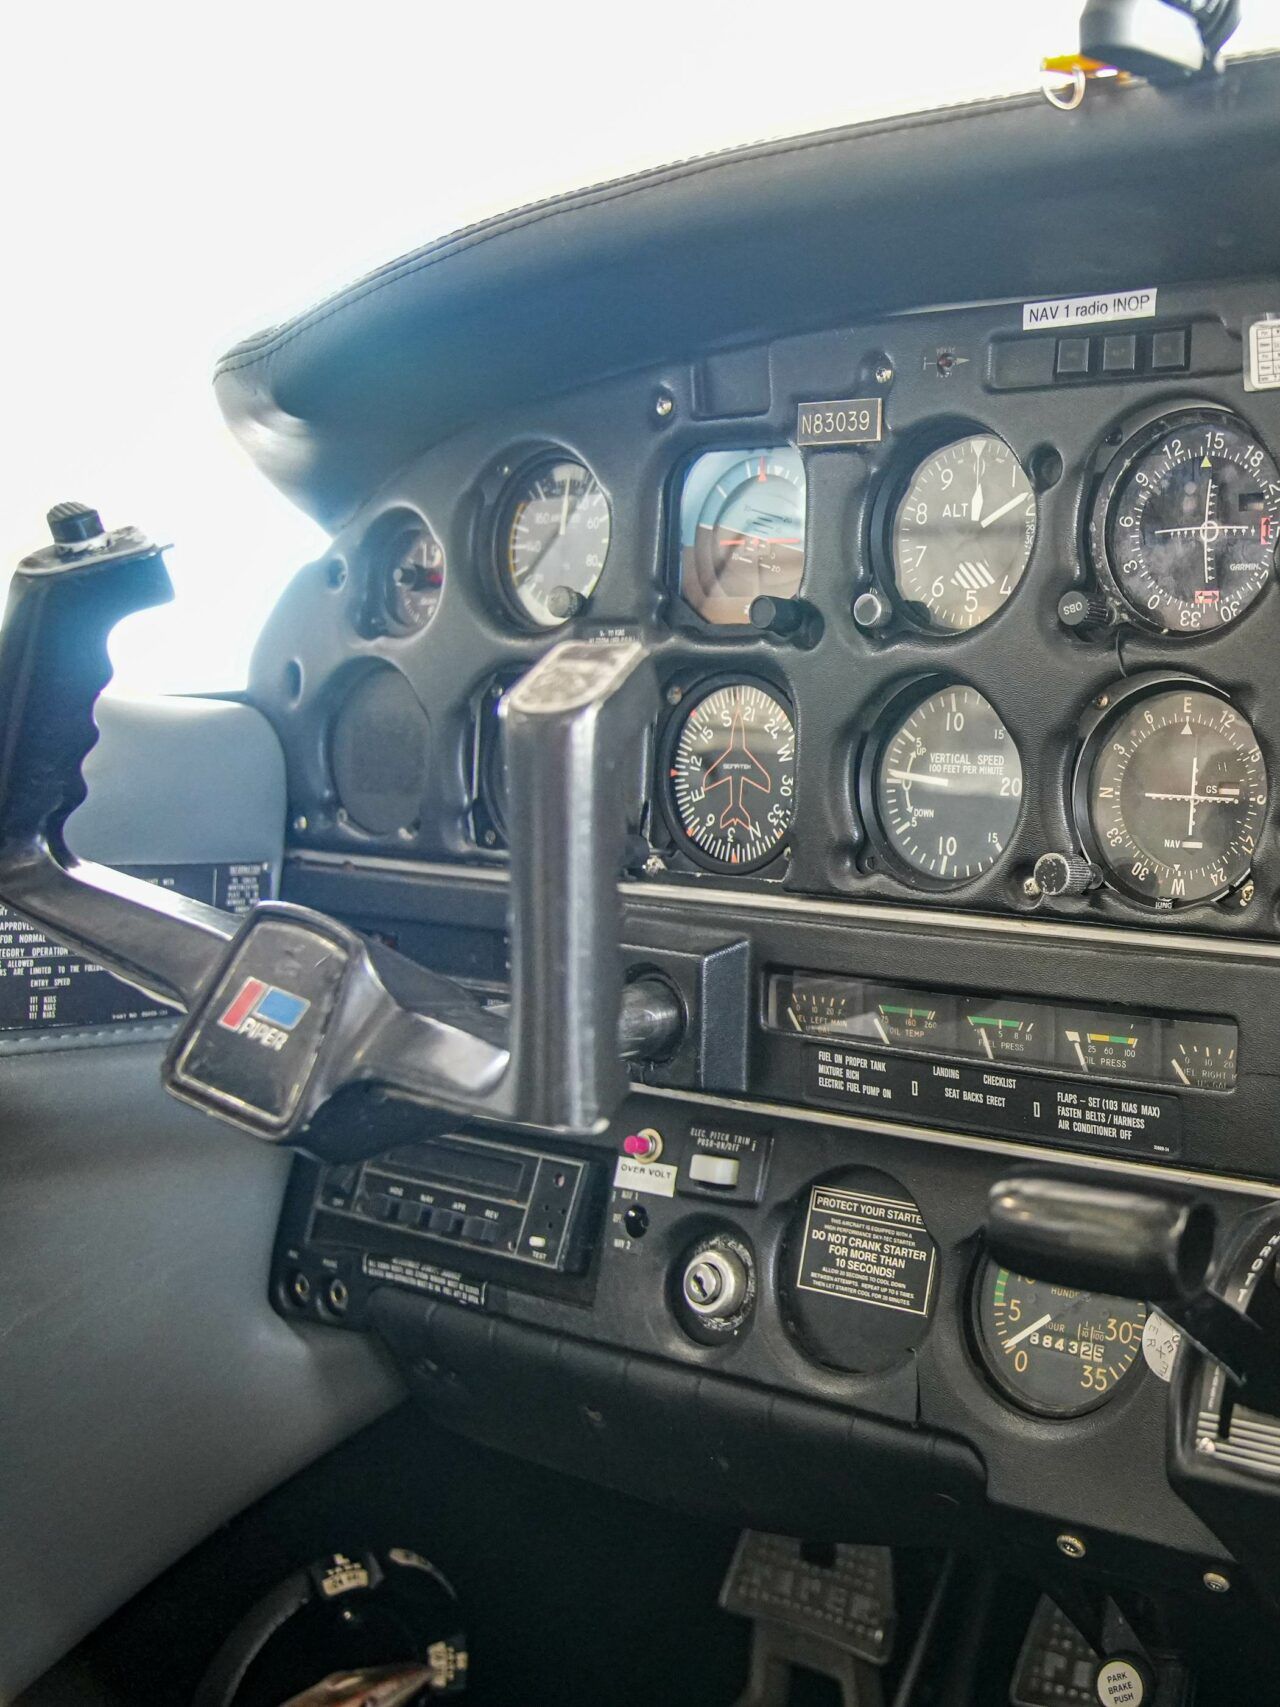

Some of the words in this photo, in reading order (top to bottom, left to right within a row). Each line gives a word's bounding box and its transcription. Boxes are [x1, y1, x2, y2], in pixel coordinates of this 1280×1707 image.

[1029, 304, 1059, 323] NAV
[1064, 303, 1070, 318] 1
[1075, 301, 1108, 316] radio
[1113, 294, 1150, 313] INOP
[801, 408, 871, 435] N83039
[1162, 439, 1185, 459] 12
[1204, 432, 1225, 449] 15
[940, 468, 953, 490] 9
[915, 502, 928, 525] 8
[942, 502, 968, 518] ALT
[916, 545, 928, 567] 7
[1230, 563, 1260, 572] GARMIN
[930, 575, 944, 597] 6
[964, 590, 978, 613] 5
[1063, 600, 1083, 616] OBS
[1183, 697, 1192, 713] E
[720, 710, 732, 728] S
[946, 712, 965, 732] 10
[994, 729, 1005, 739] 15
[777, 744, 794, 763] W
[930, 753, 971, 765] VERTICAL
[977, 754, 1005, 766] SPEED
[929, 764, 942, 773] 100
[943, 765, 961, 774] FEET
[962, 765, 977, 775] PER
[979, 766, 1005, 776] MINUTE
[690, 786, 705, 803] E
[999, 778, 1022, 797] 20
[1099, 787, 1114, 799] N
[1206, 785, 1218, 795] GS
[913, 808, 935, 818] DOWN
[749, 821, 762, 841] N
[988, 832, 999, 844] 15
[938, 836, 958, 856] 10
[1164, 839, 1181, 849] NAV
[1171, 878, 1186, 896] W
[19, 934, 46, 944] NORMAL
[32, 946, 69, 957] OPERATION
[8, 959, 34, 968] ALLOWED
[30, 979, 49, 988] ENTRY
[54, 978, 71, 987] SPEED
[811, 1016, 828, 1026] LEFT
[831, 1019, 848, 1028] MAIN
[236, 1016, 290, 1051] PIPER
[890, 1027, 901, 1036] OIL
[905, 1029, 925, 1038] TEMP
[1001, 1041, 1024, 1051] PRESS
[1087, 1045, 1097, 1054] 25
[1103, 1046, 1114, 1055] 60
[1123, 1048, 1136, 1058] 100
[818, 1051, 833, 1062] FUEL
[834, 1054, 843, 1064] ON
[845, 1055, 868, 1069] PROPER
[870, 1059, 886, 1072] TANK
[1100, 1057, 1127, 1069] PRESS
[818, 1064, 844, 1078] MIXTURE
[845, 1068, 860, 1080] RICH
[932, 1066, 960, 1079] LANDING
[818, 1077, 845, 1091] ELECTRIC
[846, 1081, 861, 1094] FUEL
[862, 1084, 880, 1097] PUMP
[882, 1088, 892, 1099] ON
[983, 1074, 1016, 1089] CHECKLIST
[945, 1087, 960, 1099] SEAT
[963, 1090, 984, 1104] BACKS
[986, 1095, 1006, 1108] ERECT
[1057, 1092, 1077, 1105] FLAPS
[1088, 1096, 1101, 1108] SET
[1102, 1098, 1118, 1111] (103
[1121, 1101, 1138, 1114] KIAS
[1141, 1104, 1161, 1118] MAX)
[1057, 1106, 1082, 1119] FASTEN
[1085, 1109, 1106, 1123] BELTS
[1113, 1113, 1145, 1129] HARNESS
[709, 1131, 731, 1142] PITCH
[734, 1134, 750, 1145] TRIM
[1058, 1120, 1070, 1131] AIR
[1073, 1123, 1117, 1139] CONDITIONER
[1119, 1129, 1133, 1141] OFF
[621, 1163, 645, 1174] OVER
[649, 1168, 672, 1180] VOLT
[817, 1196, 858, 1213] PROTECT
[860, 1204, 886, 1218] YOUR
[886, 1209, 924, 1225] STARTE
[812, 1229, 826, 1241] DO
[827, 1231, 847, 1245] NOT
[848, 1236, 882, 1252] CRANK
[883, 1243, 927, 1262] STARTER
[531, 1249, 547, 1261] TEST
[828, 1244, 848, 1257] FOR
[850, 1250, 878, 1263] MORE
[879, 1254, 906, 1269] THAN
[836, 1257, 846, 1268] 10
[848, 1260, 896, 1279] SECONDS!
[1008, 1299, 1021, 1322] 5
[1104, 1318, 1134, 1344] 30
[1014, 1350, 1028, 1373] 0
[1080, 1364, 1107, 1392] 35
[1107, 1671, 1128, 1684] PARK
[1108, 1682, 1133, 1695] BRAKE
[1113, 1692, 1134, 1704] PUSH
